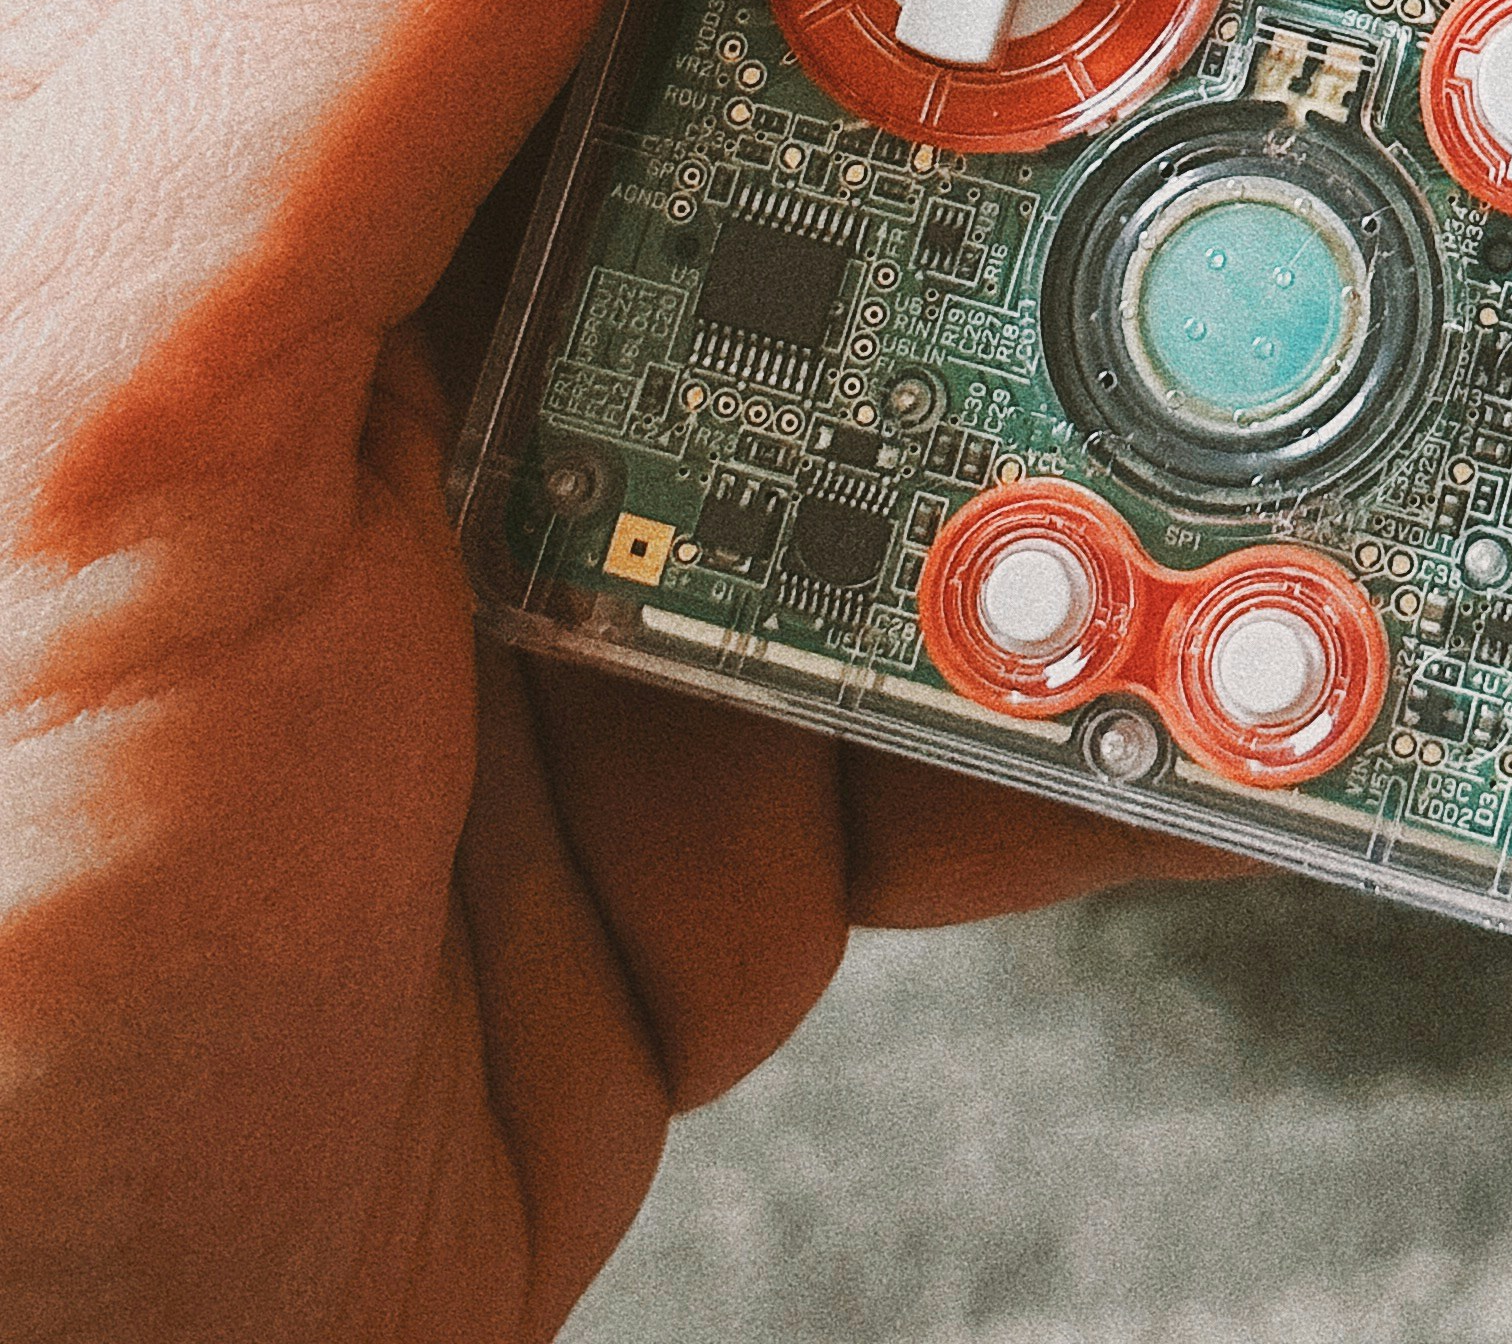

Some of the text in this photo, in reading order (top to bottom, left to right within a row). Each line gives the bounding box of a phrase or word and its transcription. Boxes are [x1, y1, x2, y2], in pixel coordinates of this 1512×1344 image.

[610, 181, 668, 210] AGND
[959, 310, 987, 355] C26
[977, 314, 1003, 361] C27
